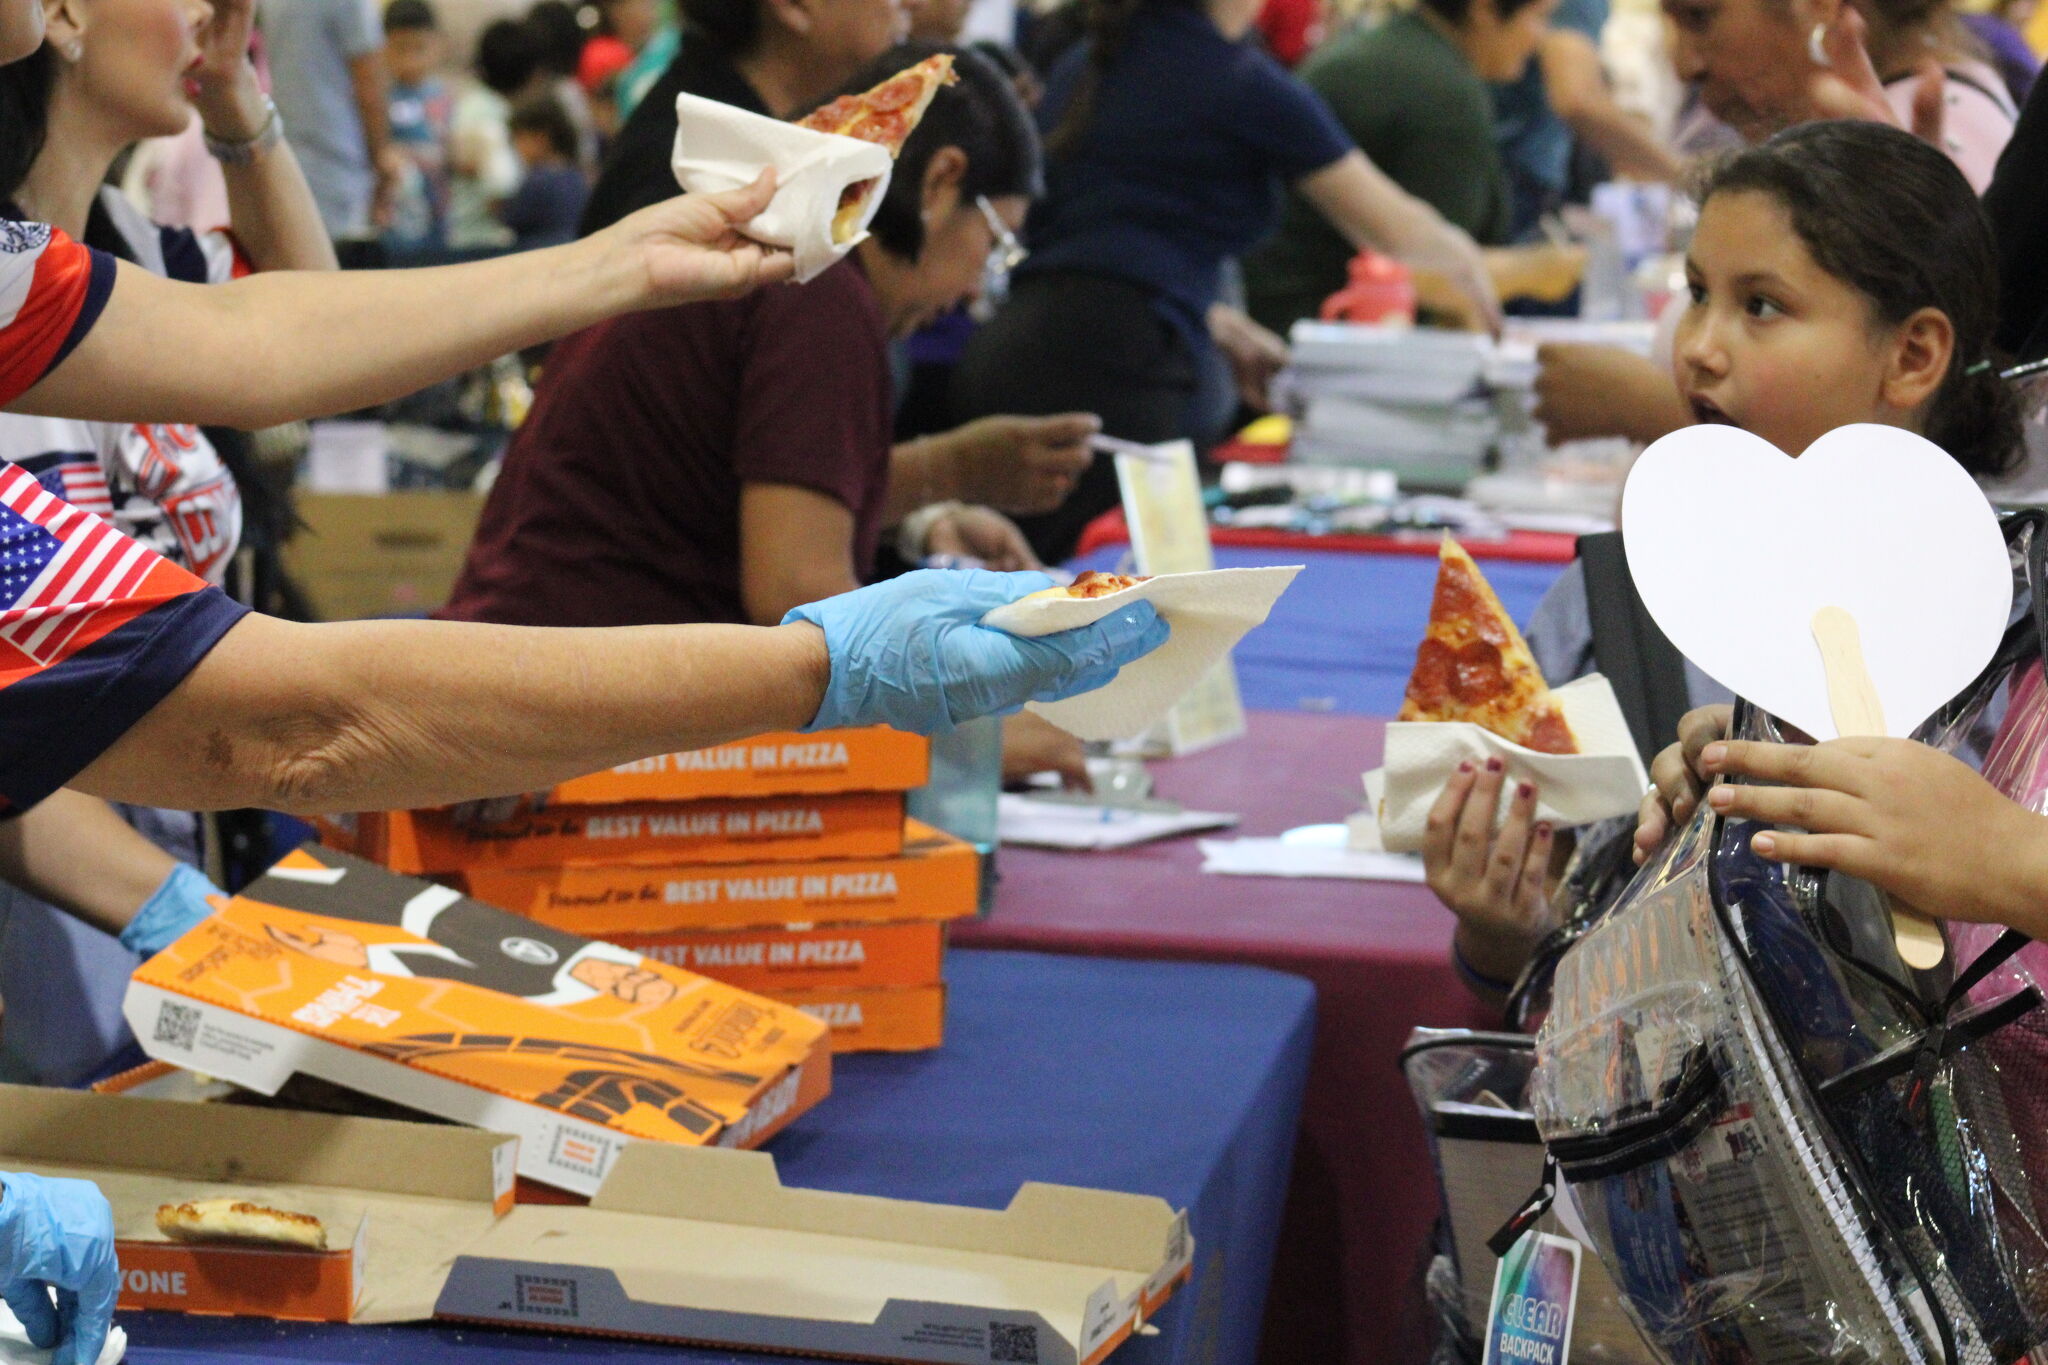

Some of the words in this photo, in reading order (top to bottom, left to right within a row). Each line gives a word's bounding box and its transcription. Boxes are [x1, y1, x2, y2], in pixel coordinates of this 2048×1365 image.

[673, 747, 745, 772] VALUE
[751, 745, 776, 768] IN
[782, 742, 848, 768] PIZZA
[585, 815, 641, 838] BEST
[649, 813, 720, 837] VALUE
[726, 811, 750, 834] IN
[755, 809, 823, 833] PIZZA
[664, 879, 718, 903] BEST
[724, 876, 797, 901] VALUE
[802, 875, 827, 898] IN
[831, 872, 897, 897] PIZZA
[693, 942, 766, 966] VALUE
[768, 942, 795, 965] IN
[798, 940, 865, 964] PIZZA
[1502, 1293, 1563, 1340] CLEAR
[1500, 1333, 1555, 1365] BACKPACK
